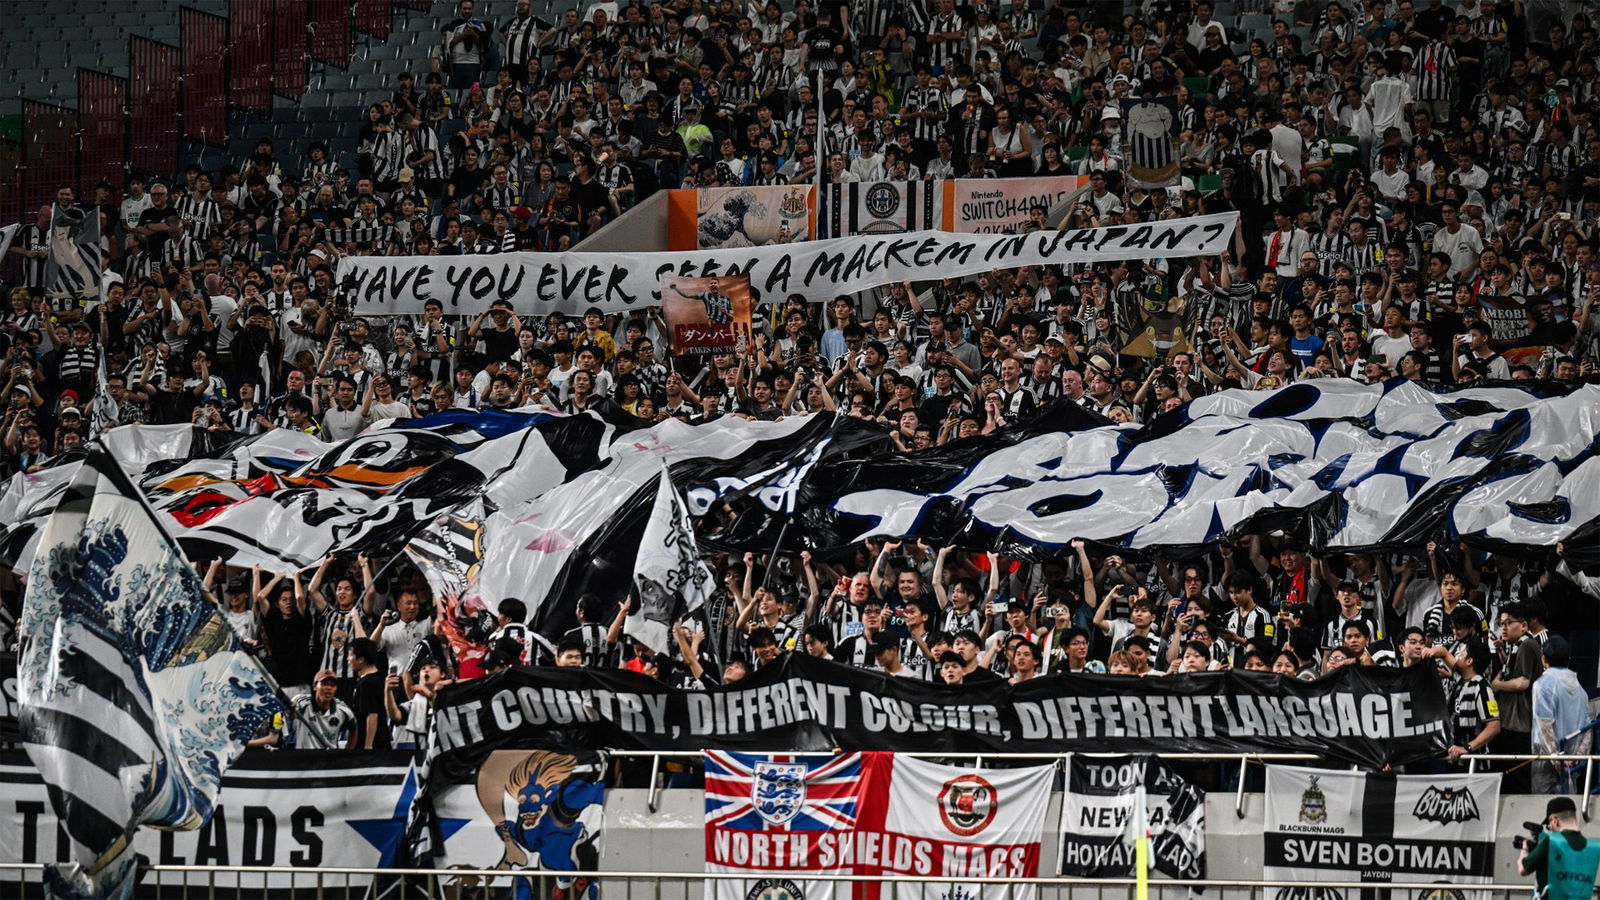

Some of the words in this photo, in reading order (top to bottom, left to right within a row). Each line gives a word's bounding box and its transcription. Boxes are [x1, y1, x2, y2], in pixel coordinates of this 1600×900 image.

[971, 190, 1003, 200] Nintendo
[347, 265, 434, 307] HAVE
[447, 263, 525, 306] YOU
[537, 262, 638, 304] EVER
[765, 253, 792, 293] A
[804, 242, 976, 287] MACKEM
[984, 232, 1029, 262] IN
[688, 346, 711, 354] TAKES
[724, 345, 738, 353] TO
[430, 700, 482, 758] NT
[493, 686, 681, 740] COUNTRY,
[689, 679, 851, 736] DIFFERENT
[861, 691, 1011, 743] COLOUR,
[1014, 694, 1219, 741] DIFFERENT
[1224, 692, 1443, 740] LANGUAGE...
[1086, 762, 1147, 788] TOON
[1417, 788, 1477, 820] BOTMAN
[160, 804, 324, 867] LADS
[1279, 824, 1322, 833] BLACKBURN
[1323, 826, 1345, 834] MAGS
[714, 829, 808, 867] NORTH
[818, 830, 933, 875] SHIELDS
[942, 844, 1026, 877] MAGS
[1066, 841, 1136, 866] HOWAY
[1283, 838, 1351, 865] SVEN
[1357, 842, 1472, 870] BOTMAN
[1362, 870, 1391, 879] JAYDEN
